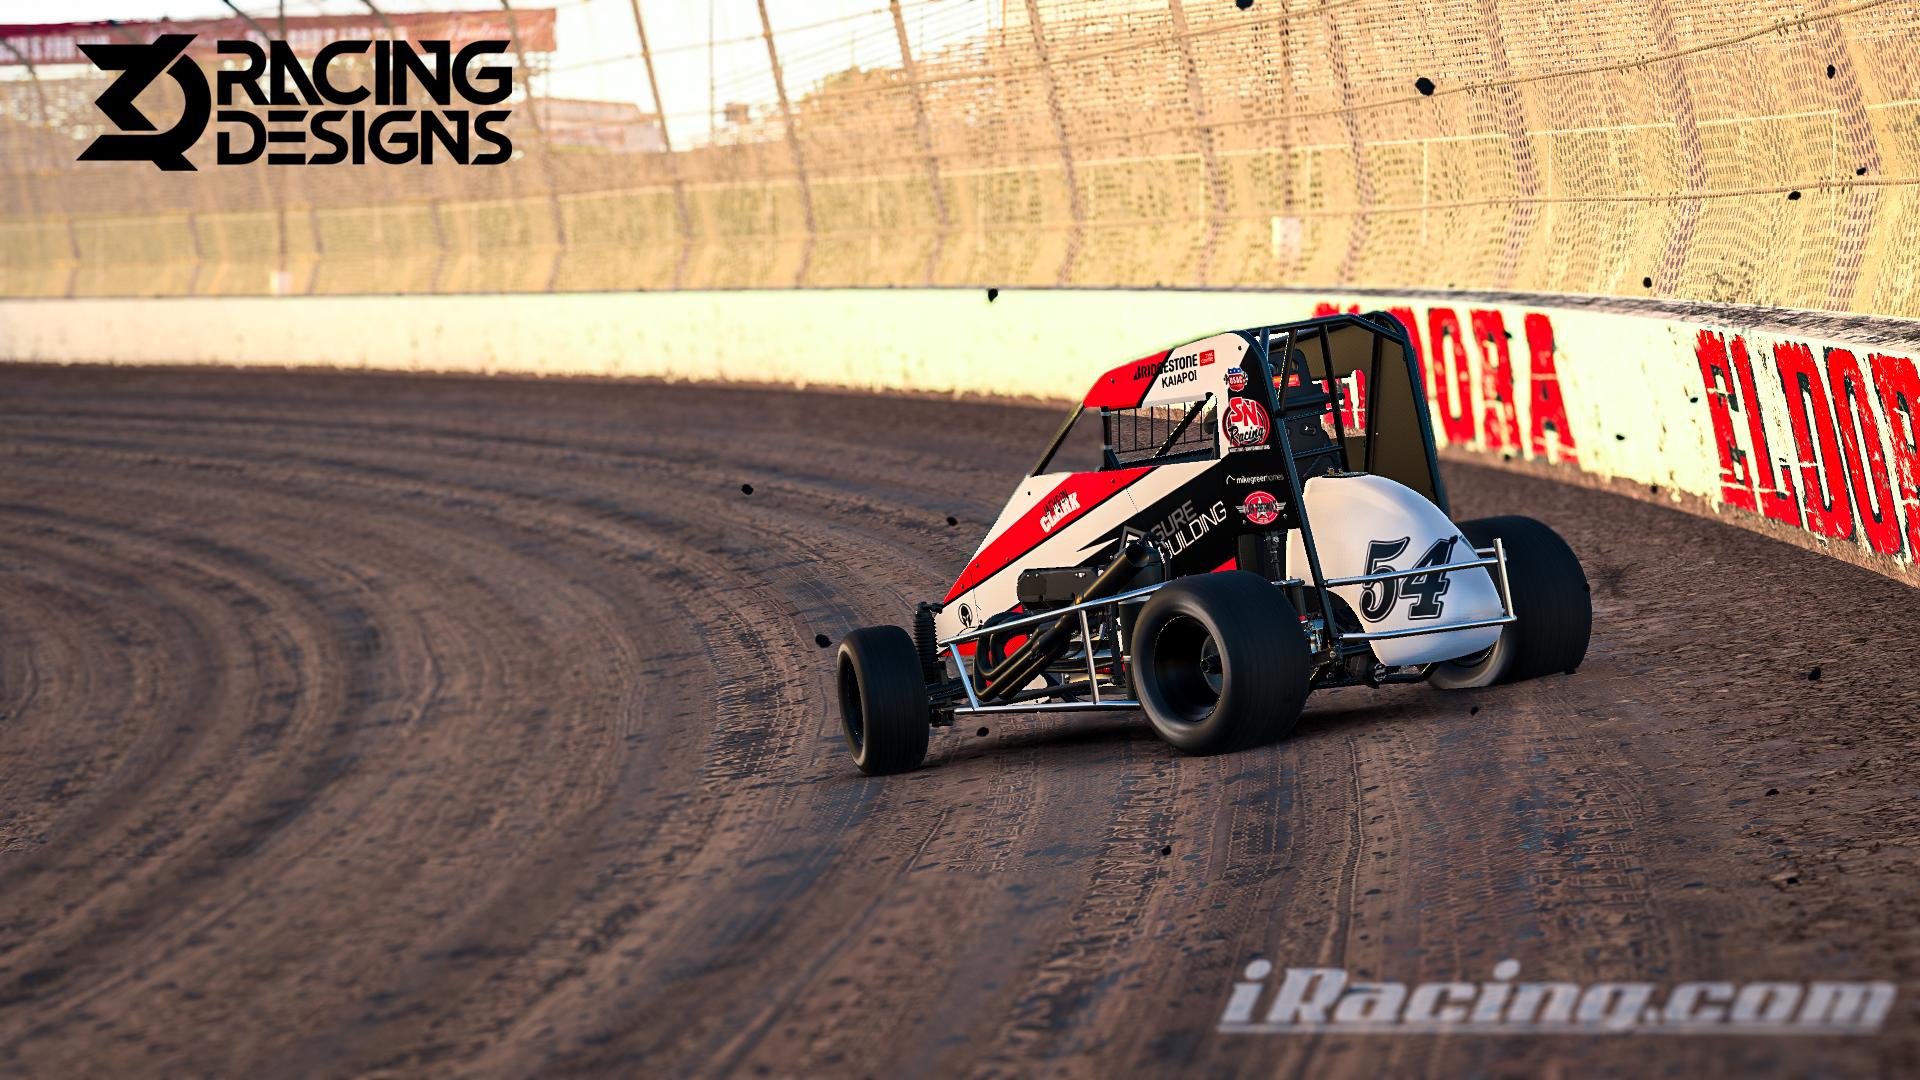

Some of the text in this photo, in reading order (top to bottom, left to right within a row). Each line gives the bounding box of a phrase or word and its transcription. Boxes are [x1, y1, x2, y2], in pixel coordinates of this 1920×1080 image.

[1161, 369, 1198, 389] KAIAPOI
[1229, 396, 1259, 427] SN
[1228, 425, 1265, 446] Racing
[1039, 491, 1081, 533] CLARK
[1359, 536, 1459, 623] 54
